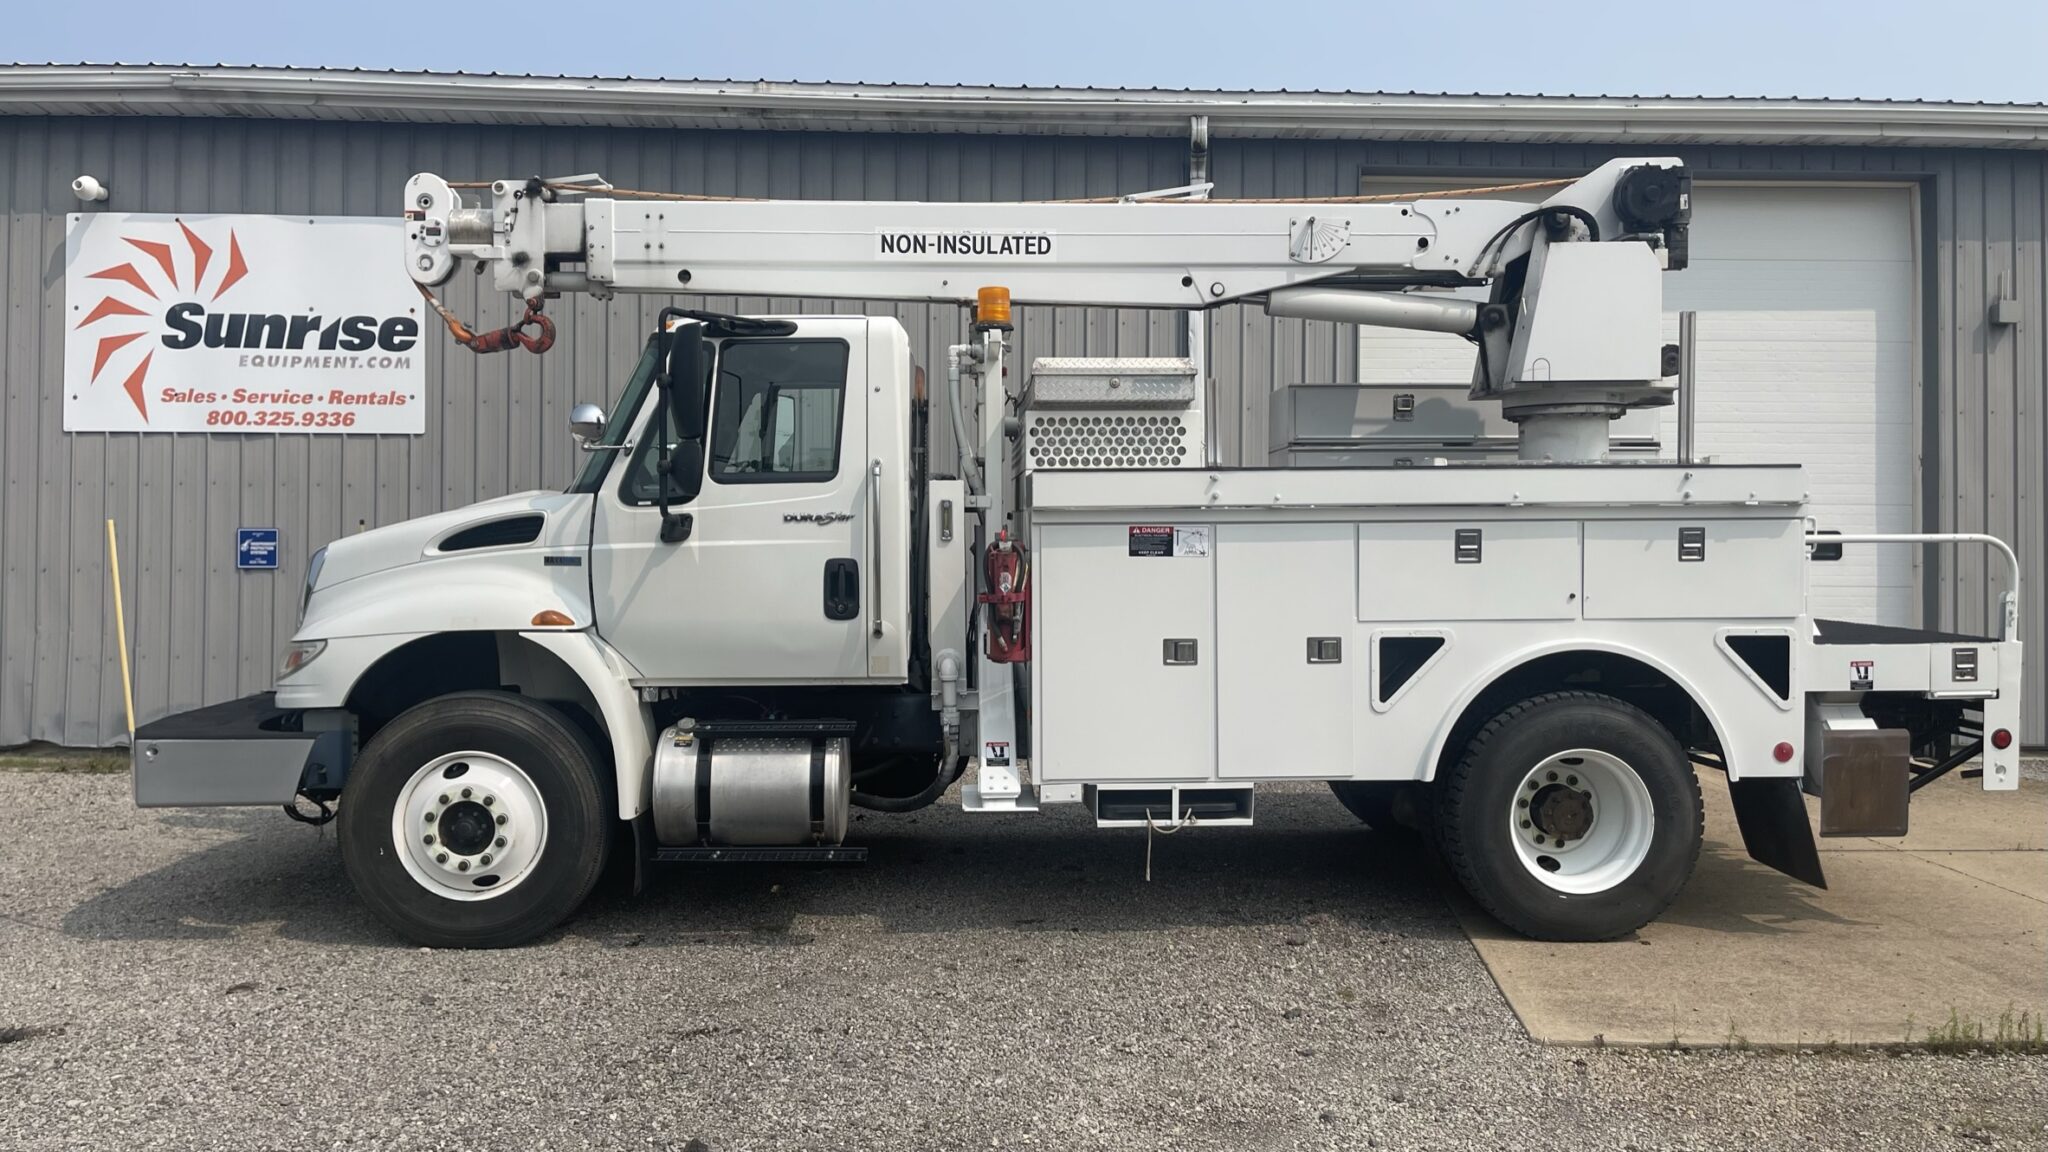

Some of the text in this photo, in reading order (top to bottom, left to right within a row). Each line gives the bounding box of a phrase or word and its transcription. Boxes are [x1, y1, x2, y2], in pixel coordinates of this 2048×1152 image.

[881, 234, 1051, 255] NON-INSULATED
[161, 302, 419, 352] Sunrise
[239, 354, 411, 369] EQUIPMENT.COM
[161, 388, 406, 406] Sales Service Rentals
[206, 410, 355, 427] 800.325.9336
